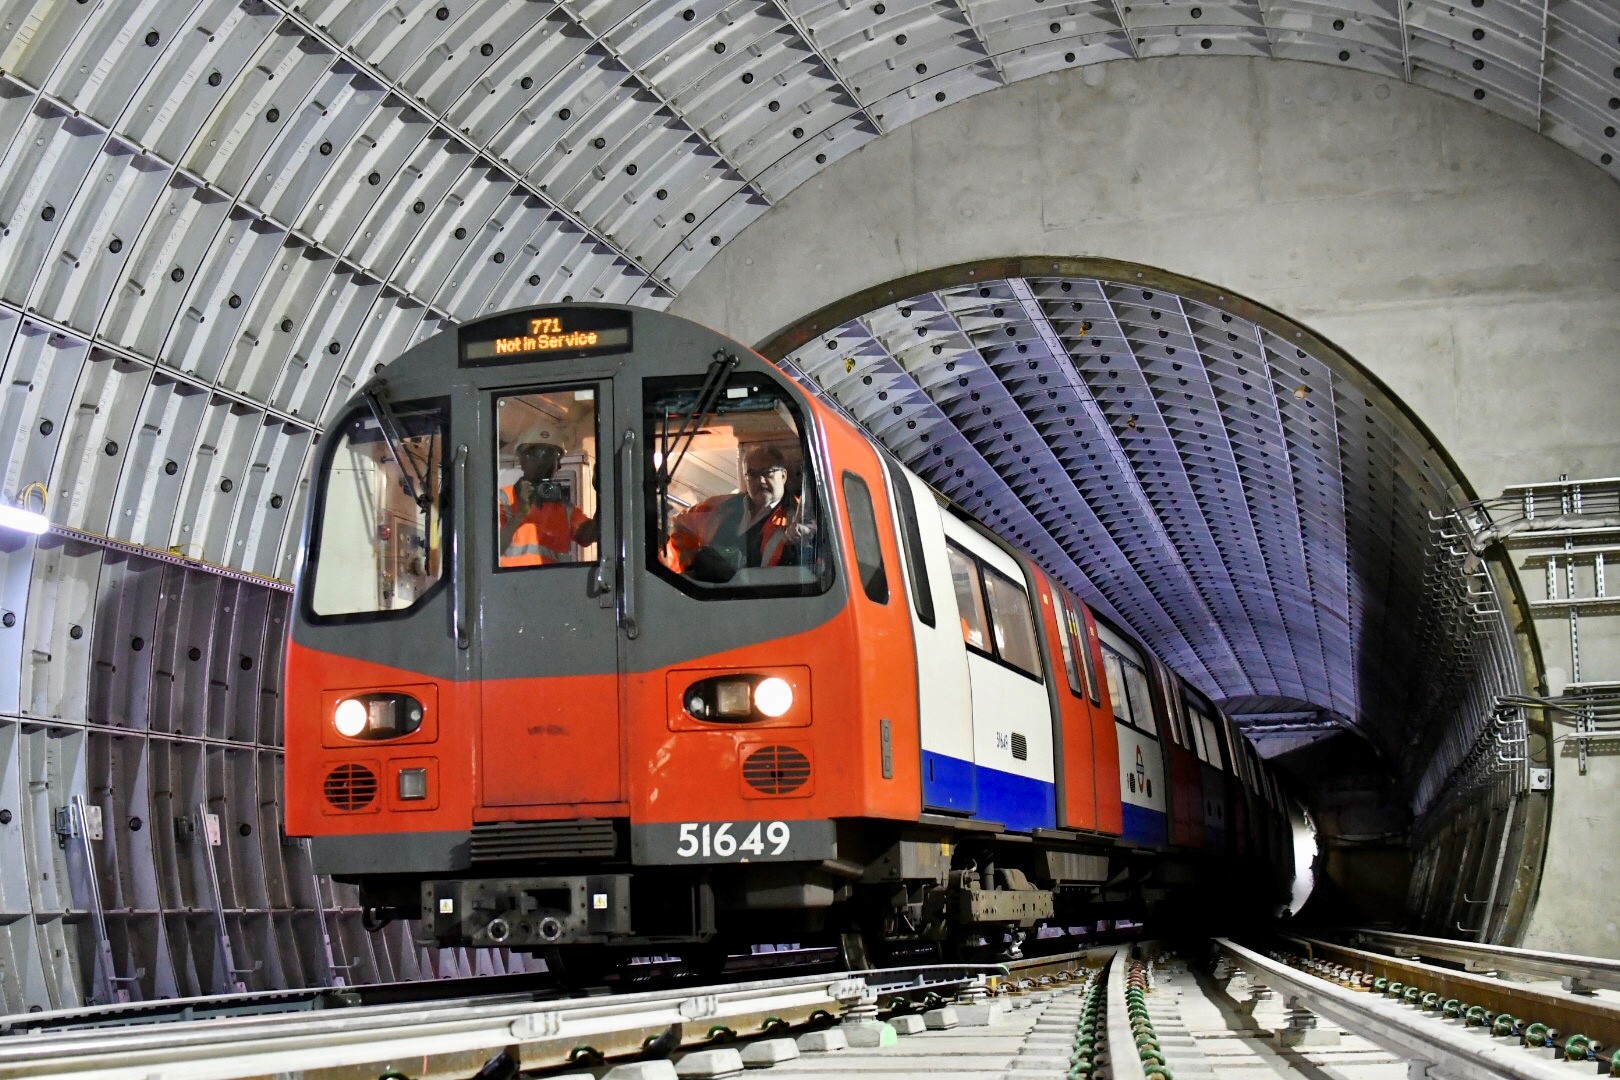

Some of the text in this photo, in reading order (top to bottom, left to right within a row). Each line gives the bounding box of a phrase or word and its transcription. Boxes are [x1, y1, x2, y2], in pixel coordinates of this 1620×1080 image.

[531, 318, 562, 334] 771
[496, 331, 598, 353] Not in Service
[676, 821, 791, 857] 51649
